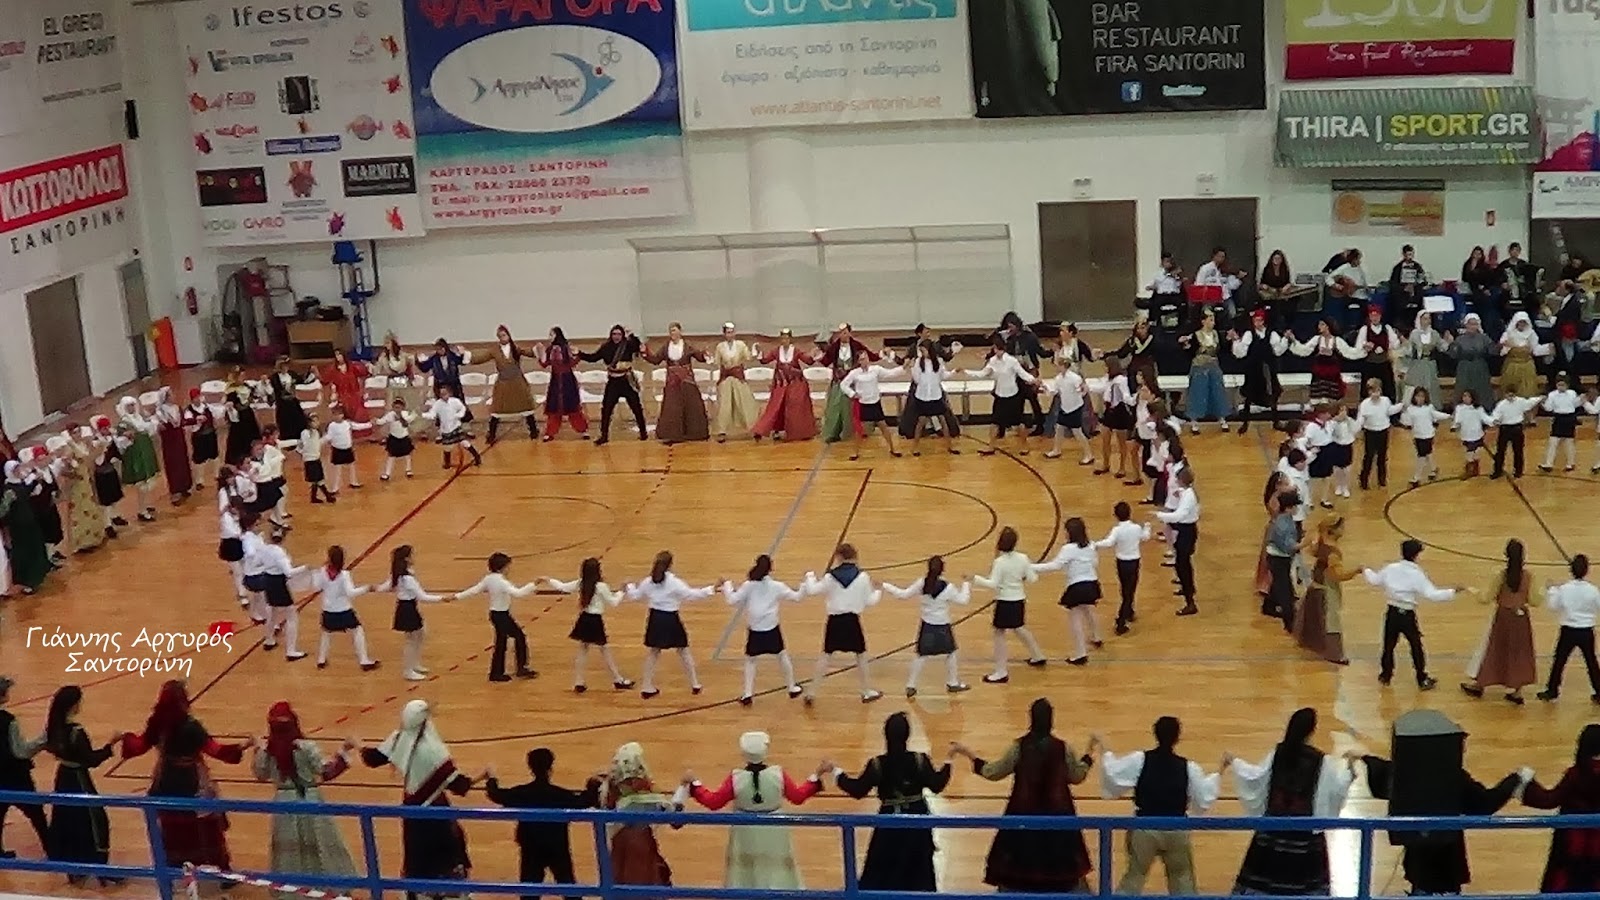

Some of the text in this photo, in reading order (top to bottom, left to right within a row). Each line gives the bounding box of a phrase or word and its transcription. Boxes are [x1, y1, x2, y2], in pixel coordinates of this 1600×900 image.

[231, 3, 343, 28] Ifestos
[1092, 2, 1141, 25] BAR
[43, 17, 60, 35] EL
[1093, 24, 1242, 49] RESTAURANT
[1095, 52, 1246, 73] FIRA SANTORINI
[1283, 113, 1530, 139] THIRA SPORT.GR
